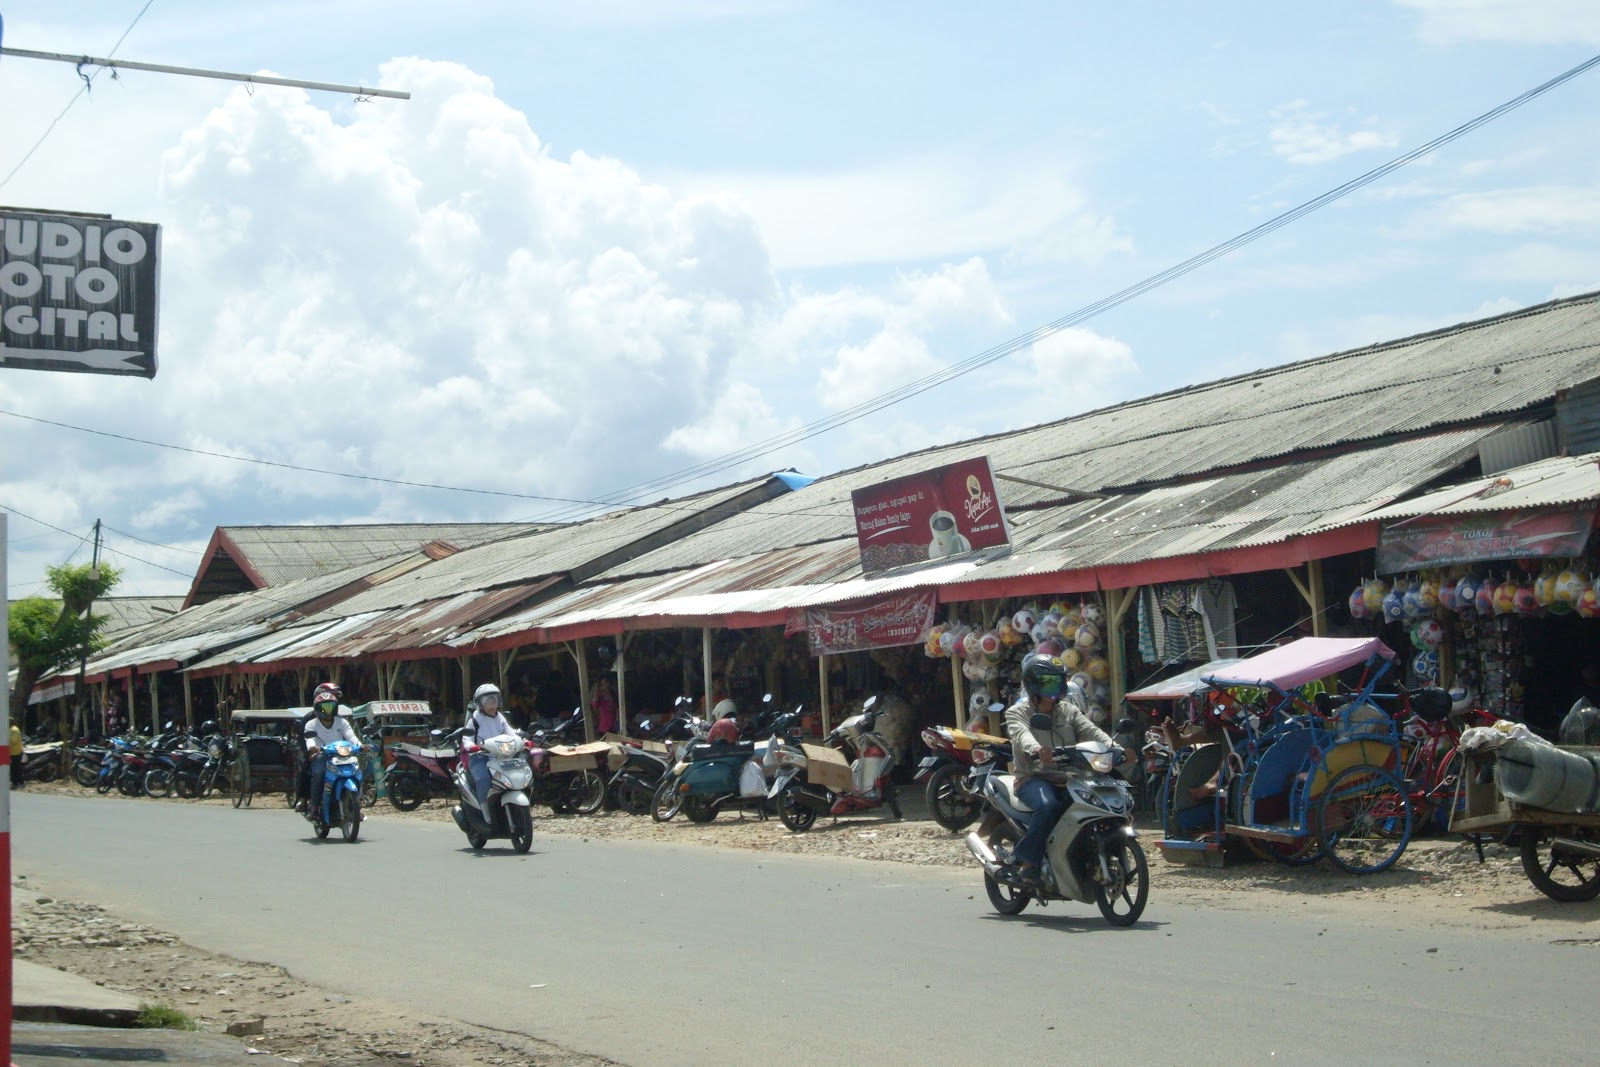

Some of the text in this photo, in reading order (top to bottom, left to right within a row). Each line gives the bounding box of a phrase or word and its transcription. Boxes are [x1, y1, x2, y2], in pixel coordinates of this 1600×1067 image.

[0, 218, 147, 265] UDIO
[0, 304, 139, 342] GITAL
[981, 491, 992, 509] Api
[1422, 534, 1521, 557] OM ASRIL
[1463, 528, 1490, 540] TOKO
